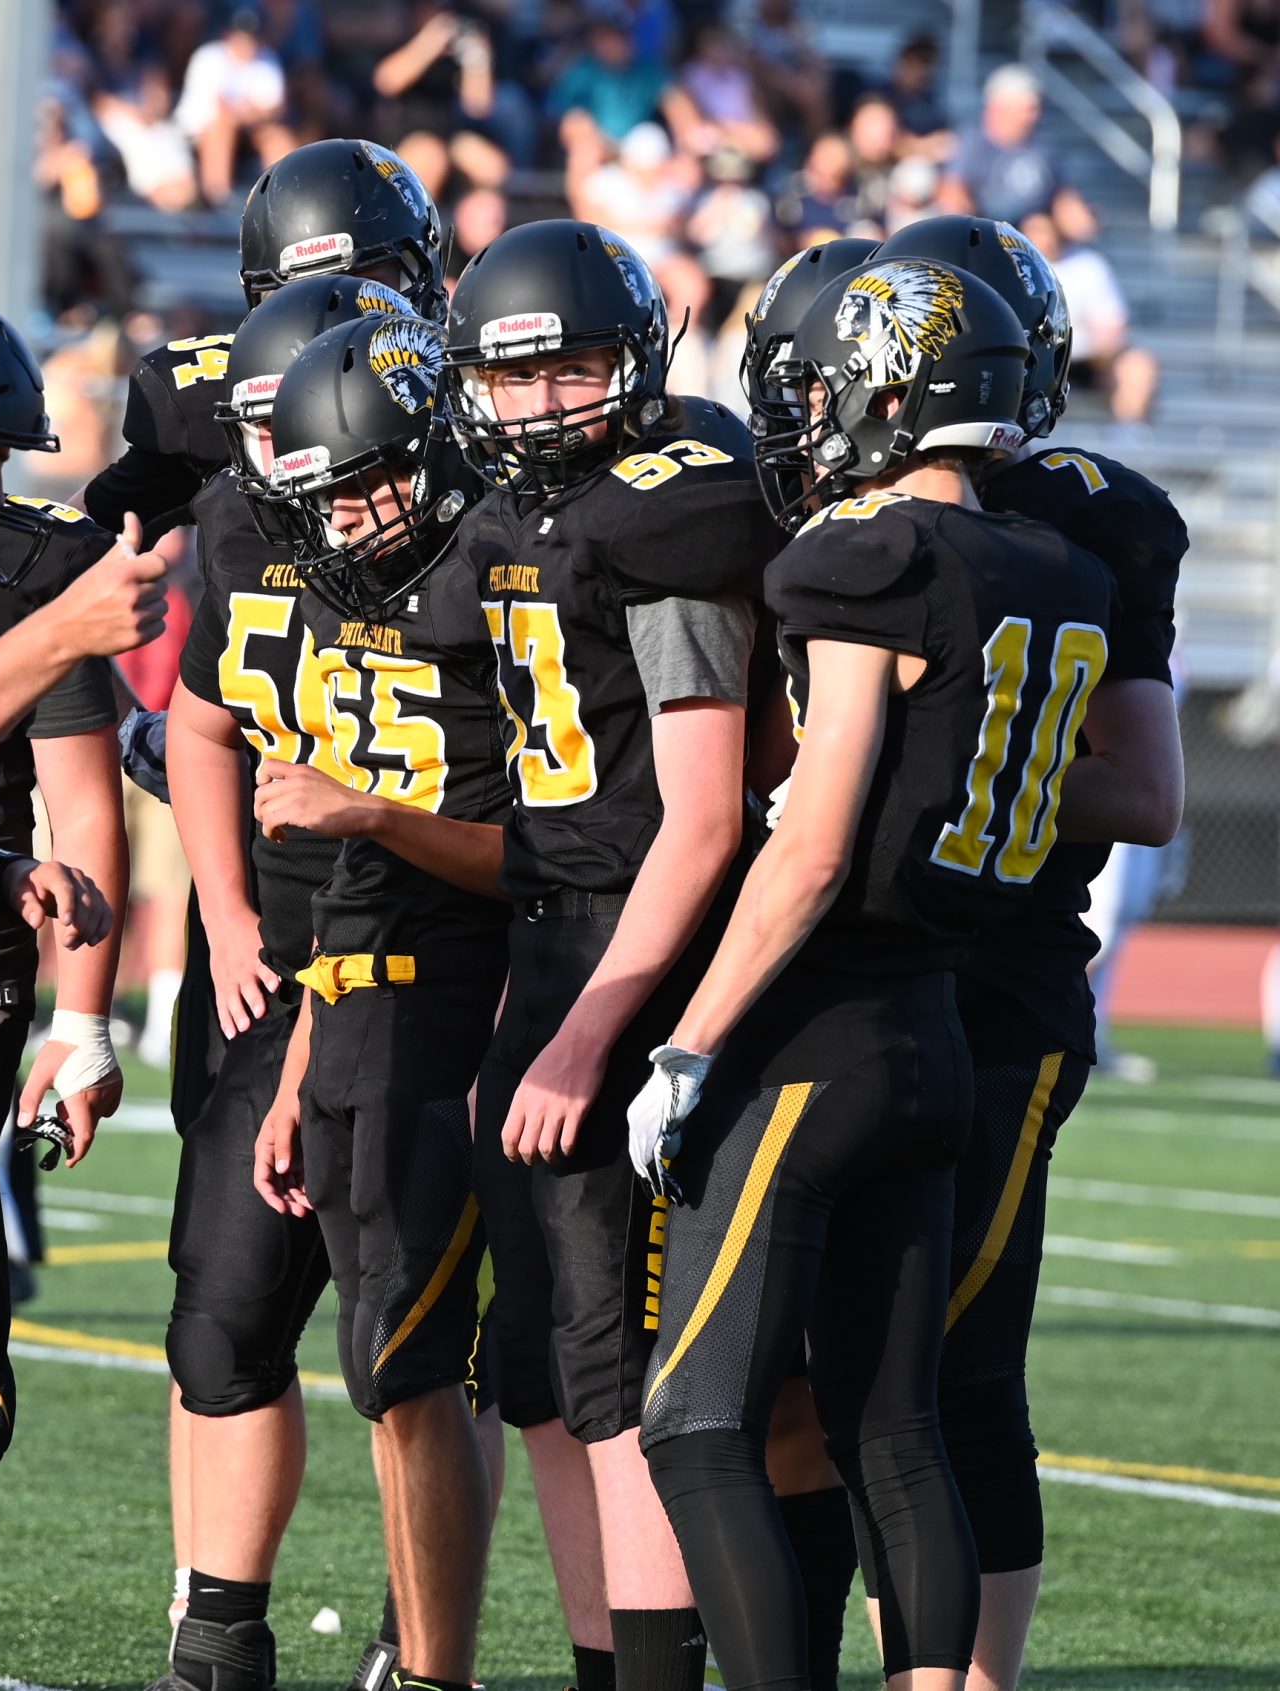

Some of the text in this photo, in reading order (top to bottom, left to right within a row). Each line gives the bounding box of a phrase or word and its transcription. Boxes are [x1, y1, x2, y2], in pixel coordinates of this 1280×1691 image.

[295, 238, 337, 257] Riddell
[498, 316, 543, 333] Riddell
[609, 439, 735, 491] 53
[1039, 452, 1109, 495] 7
[261, 564, 307, 589] PHIL
[489, 564, 540, 594] PHILOMATH
[928, 616, 1109, 884] 10
